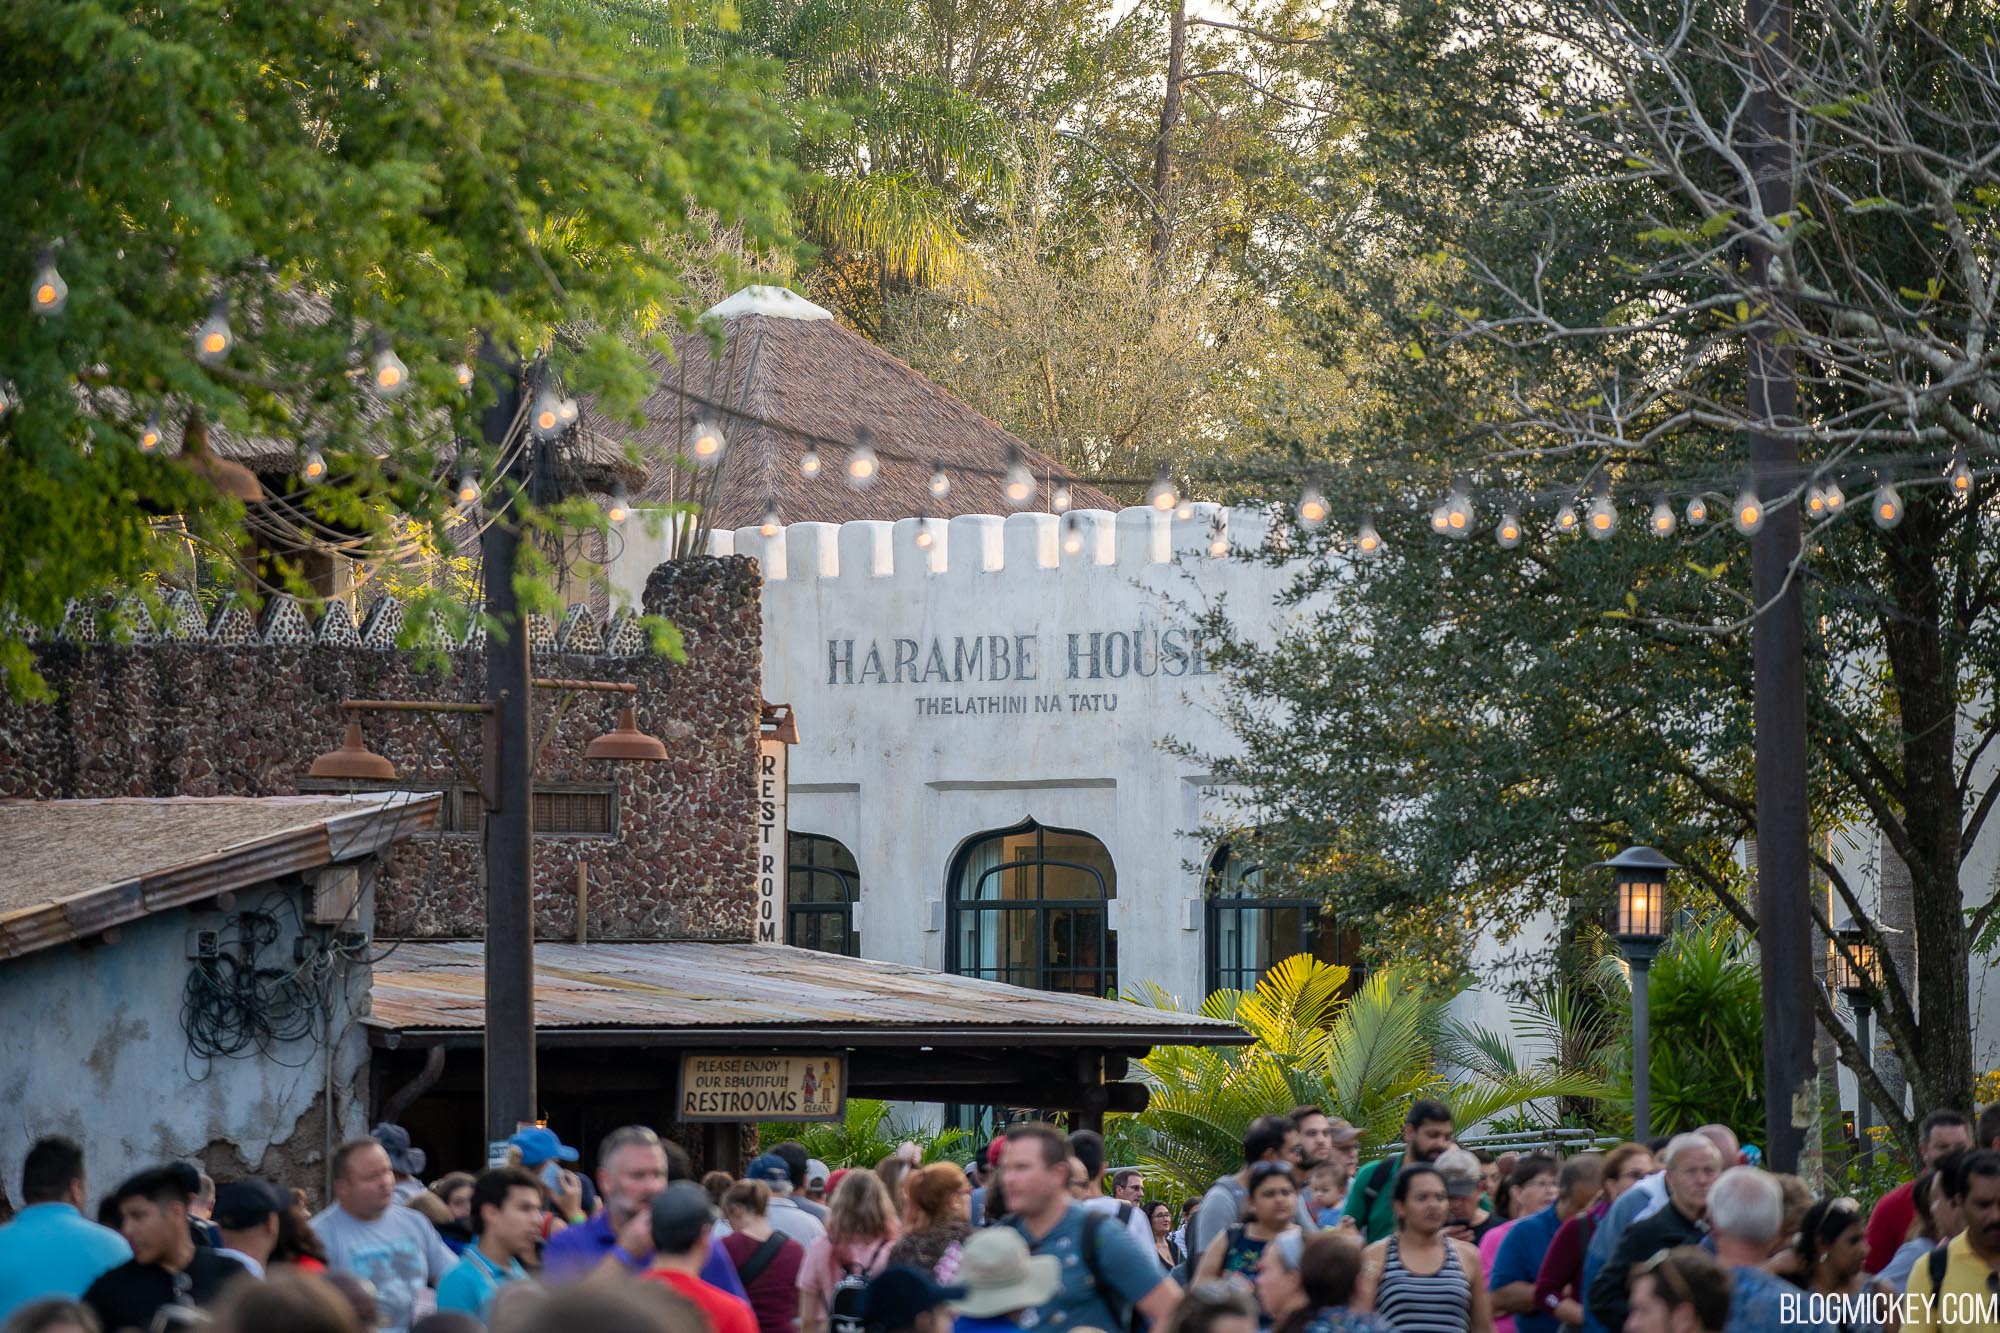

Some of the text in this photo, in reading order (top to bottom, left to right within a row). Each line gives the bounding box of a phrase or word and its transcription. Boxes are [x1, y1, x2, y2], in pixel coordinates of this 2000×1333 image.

[827, 634, 1038, 685] HARAMBE
[915, 693, 1118, 716] THELATHINI NA TATU
[696, 1060, 780, 1073] PLEASE ENJOY
[696, 1076, 721, 1088] OUR
[685, 1091, 797, 1112] RESTROOMS
